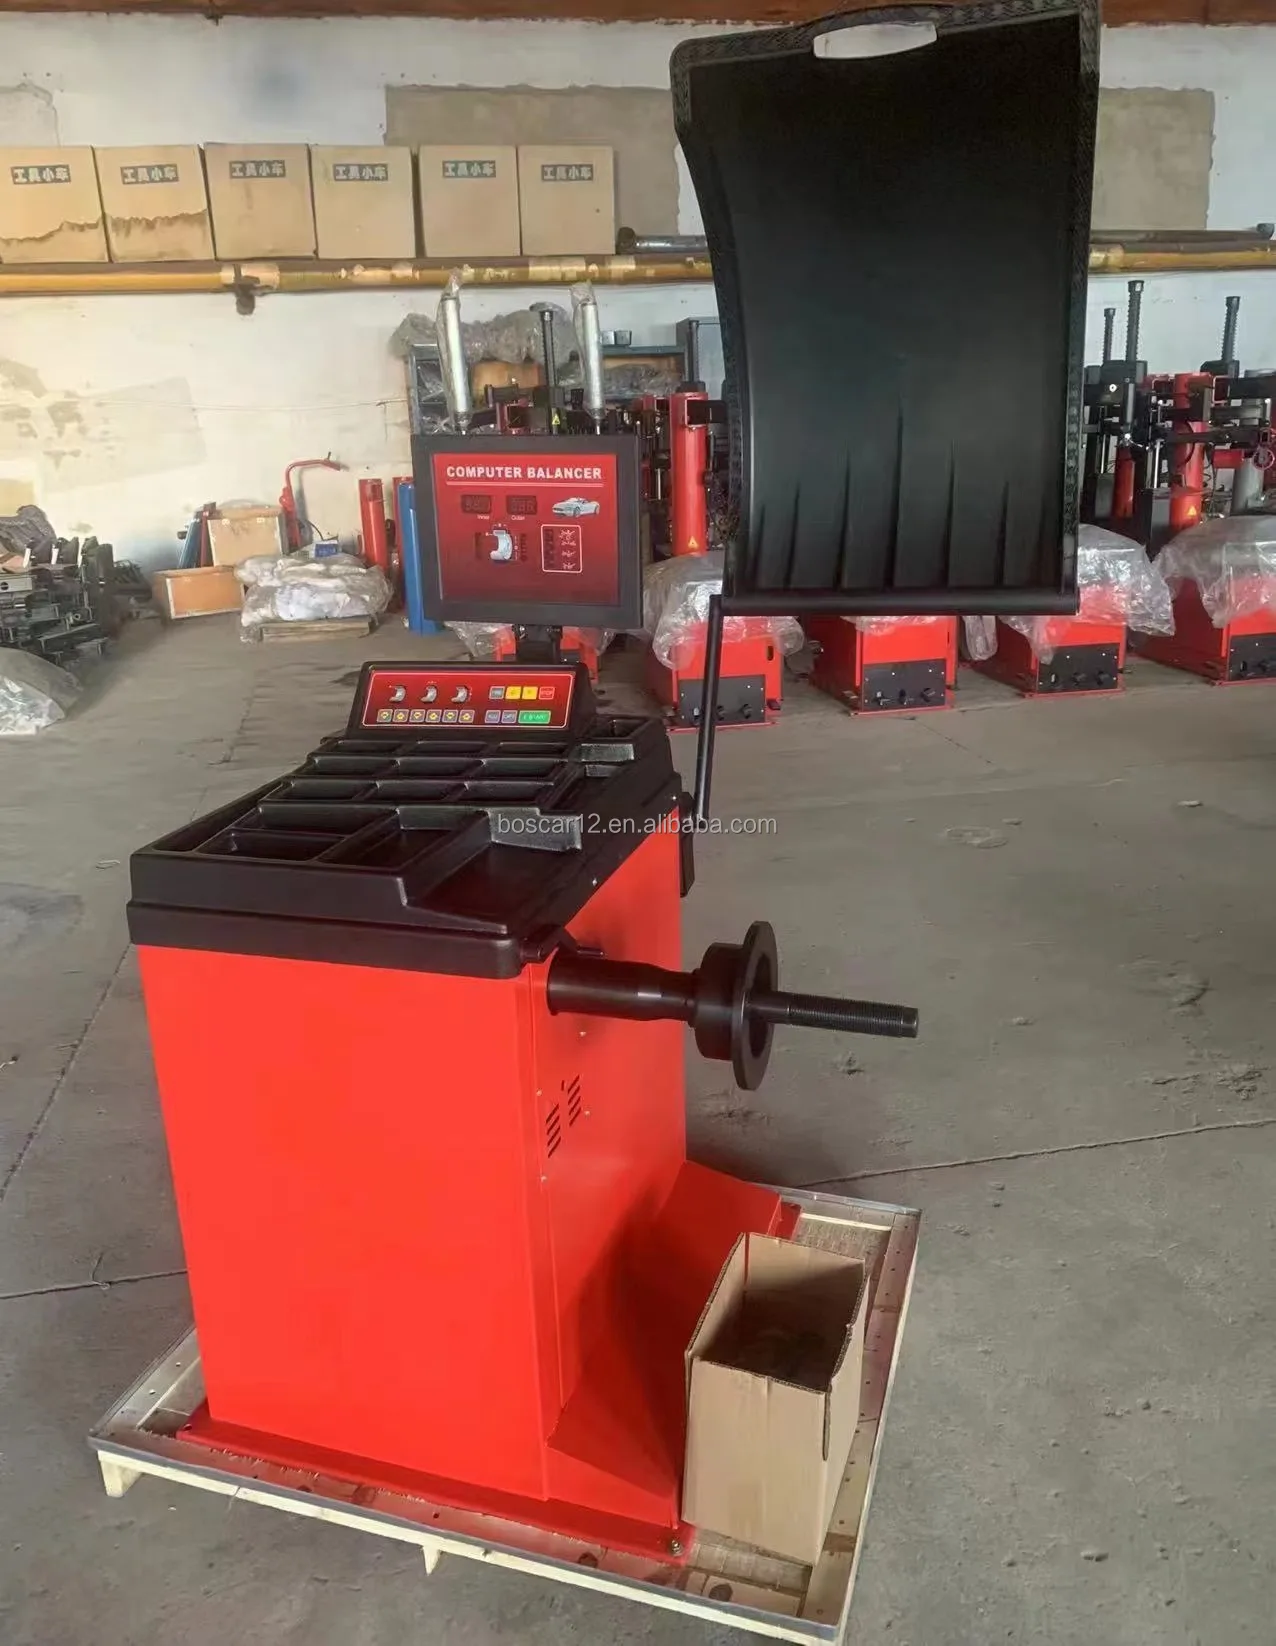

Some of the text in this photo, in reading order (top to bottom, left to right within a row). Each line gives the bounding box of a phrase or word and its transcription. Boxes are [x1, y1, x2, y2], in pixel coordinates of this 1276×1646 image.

[13, 165, 70, 183] 工具小车
[123, 165, 178, 183] 工具小车
[231, 161, 284, 178] 工具小车
[335, 164, 388, 180] 工具小车
[444, 161, 495, 177] 工具小车
[543, 165, 592, 180] 工具小车
[446, 466, 602, 480] COMPUTER BALANCER
